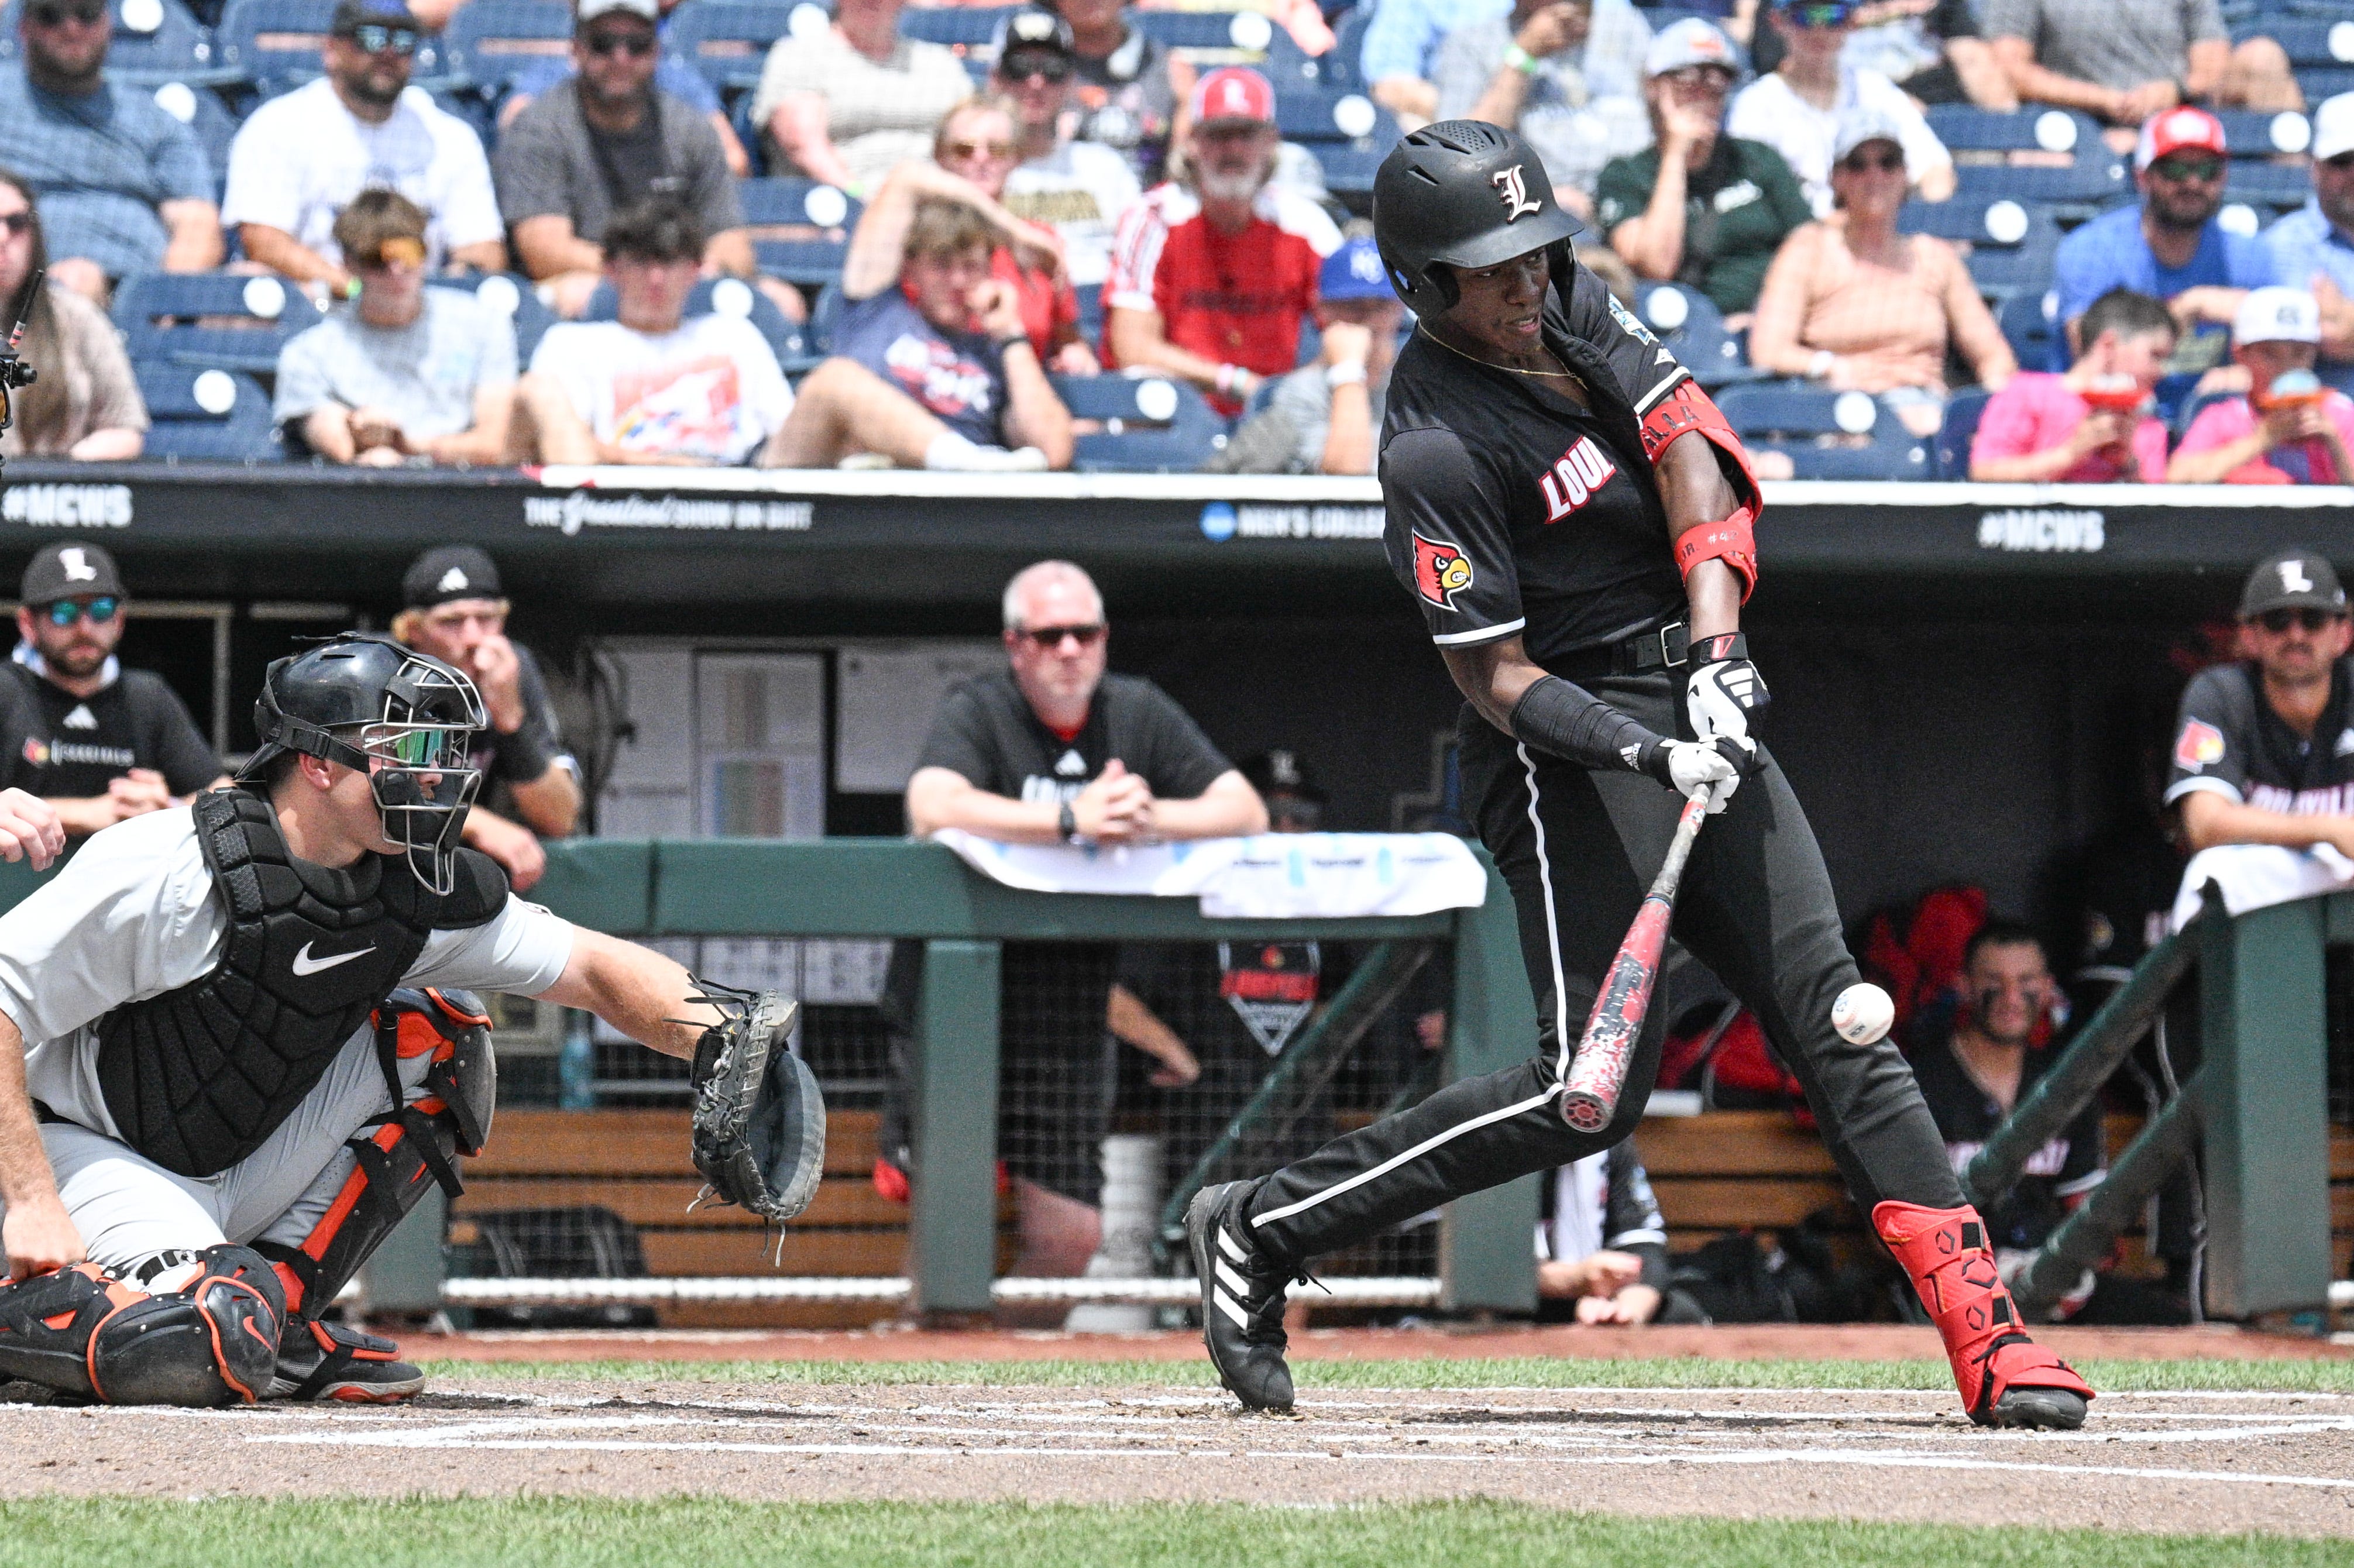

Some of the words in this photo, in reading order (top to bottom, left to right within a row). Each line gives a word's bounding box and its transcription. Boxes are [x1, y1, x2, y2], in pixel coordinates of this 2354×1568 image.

[1488, 164, 1542, 225] L
[1, 483, 132, 527] #MCWS
[1977, 508, 2106, 552] #MCWS
